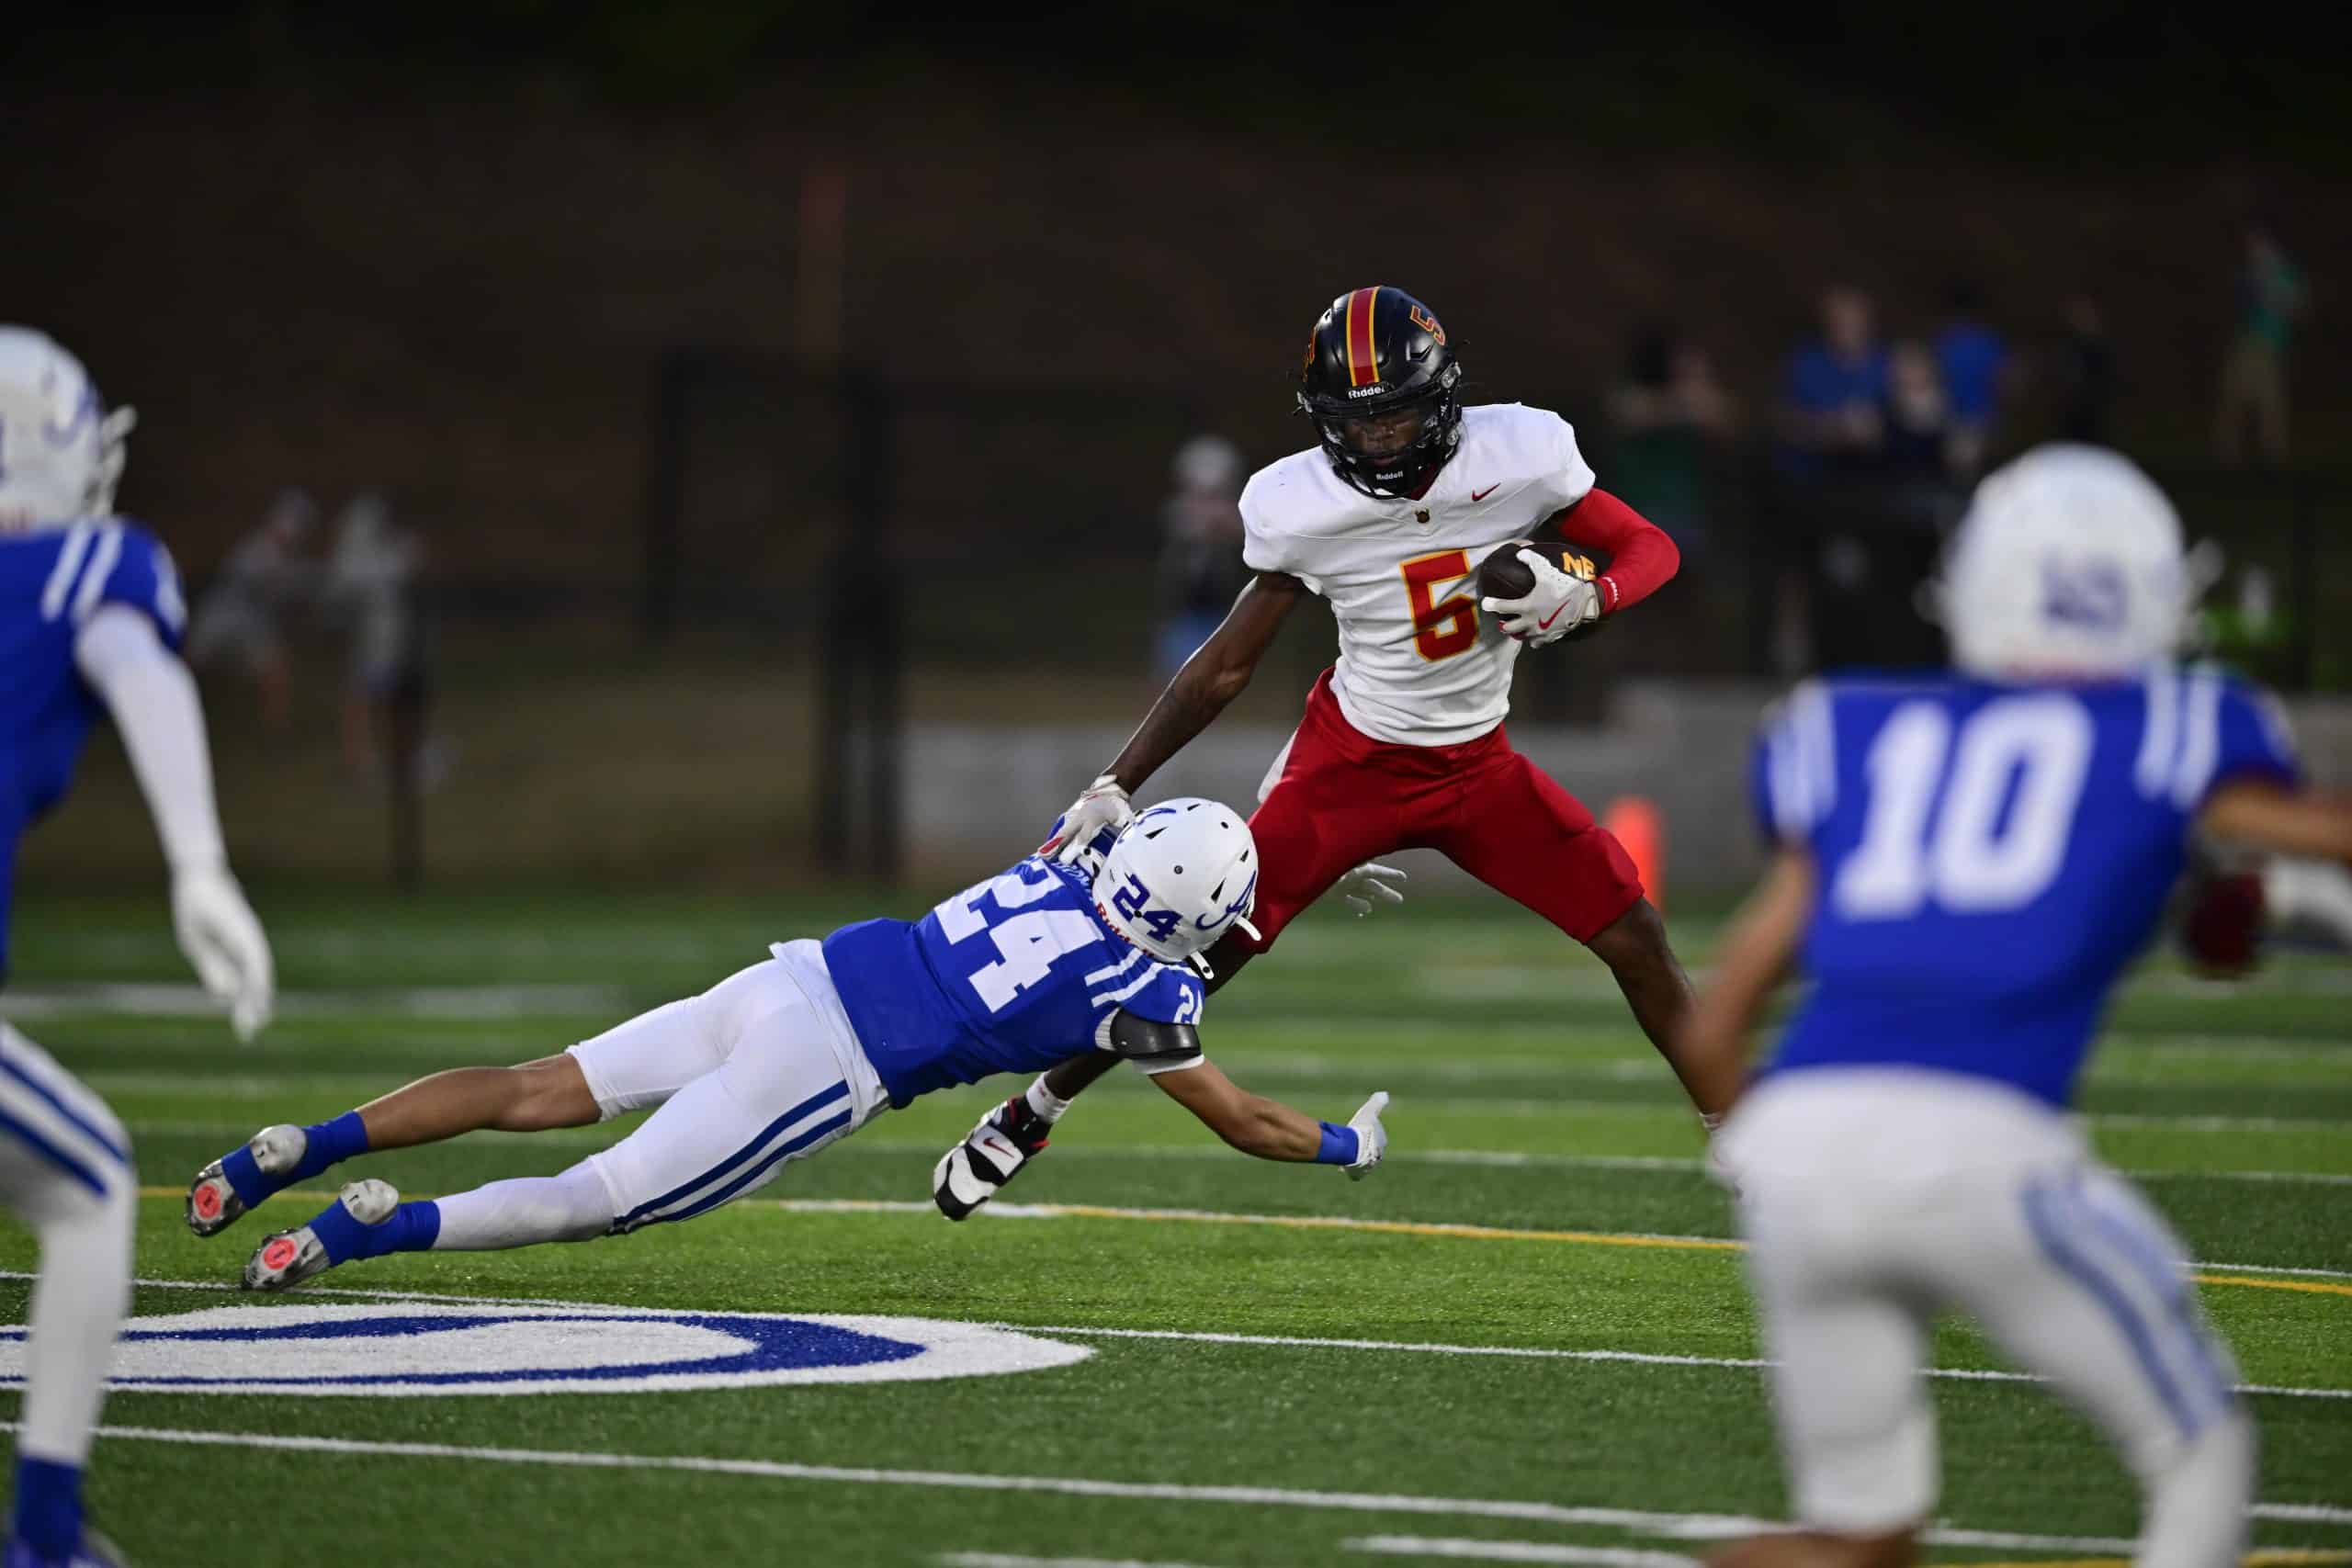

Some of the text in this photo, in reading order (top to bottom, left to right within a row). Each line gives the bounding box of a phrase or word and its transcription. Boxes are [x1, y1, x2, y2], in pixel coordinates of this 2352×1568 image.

[1409, 304, 1446, 346] 5
[1837, 698, 2095, 921] 10
[933, 857, 1105, 1013] 24
[1112, 874, 1183, 942] 24
